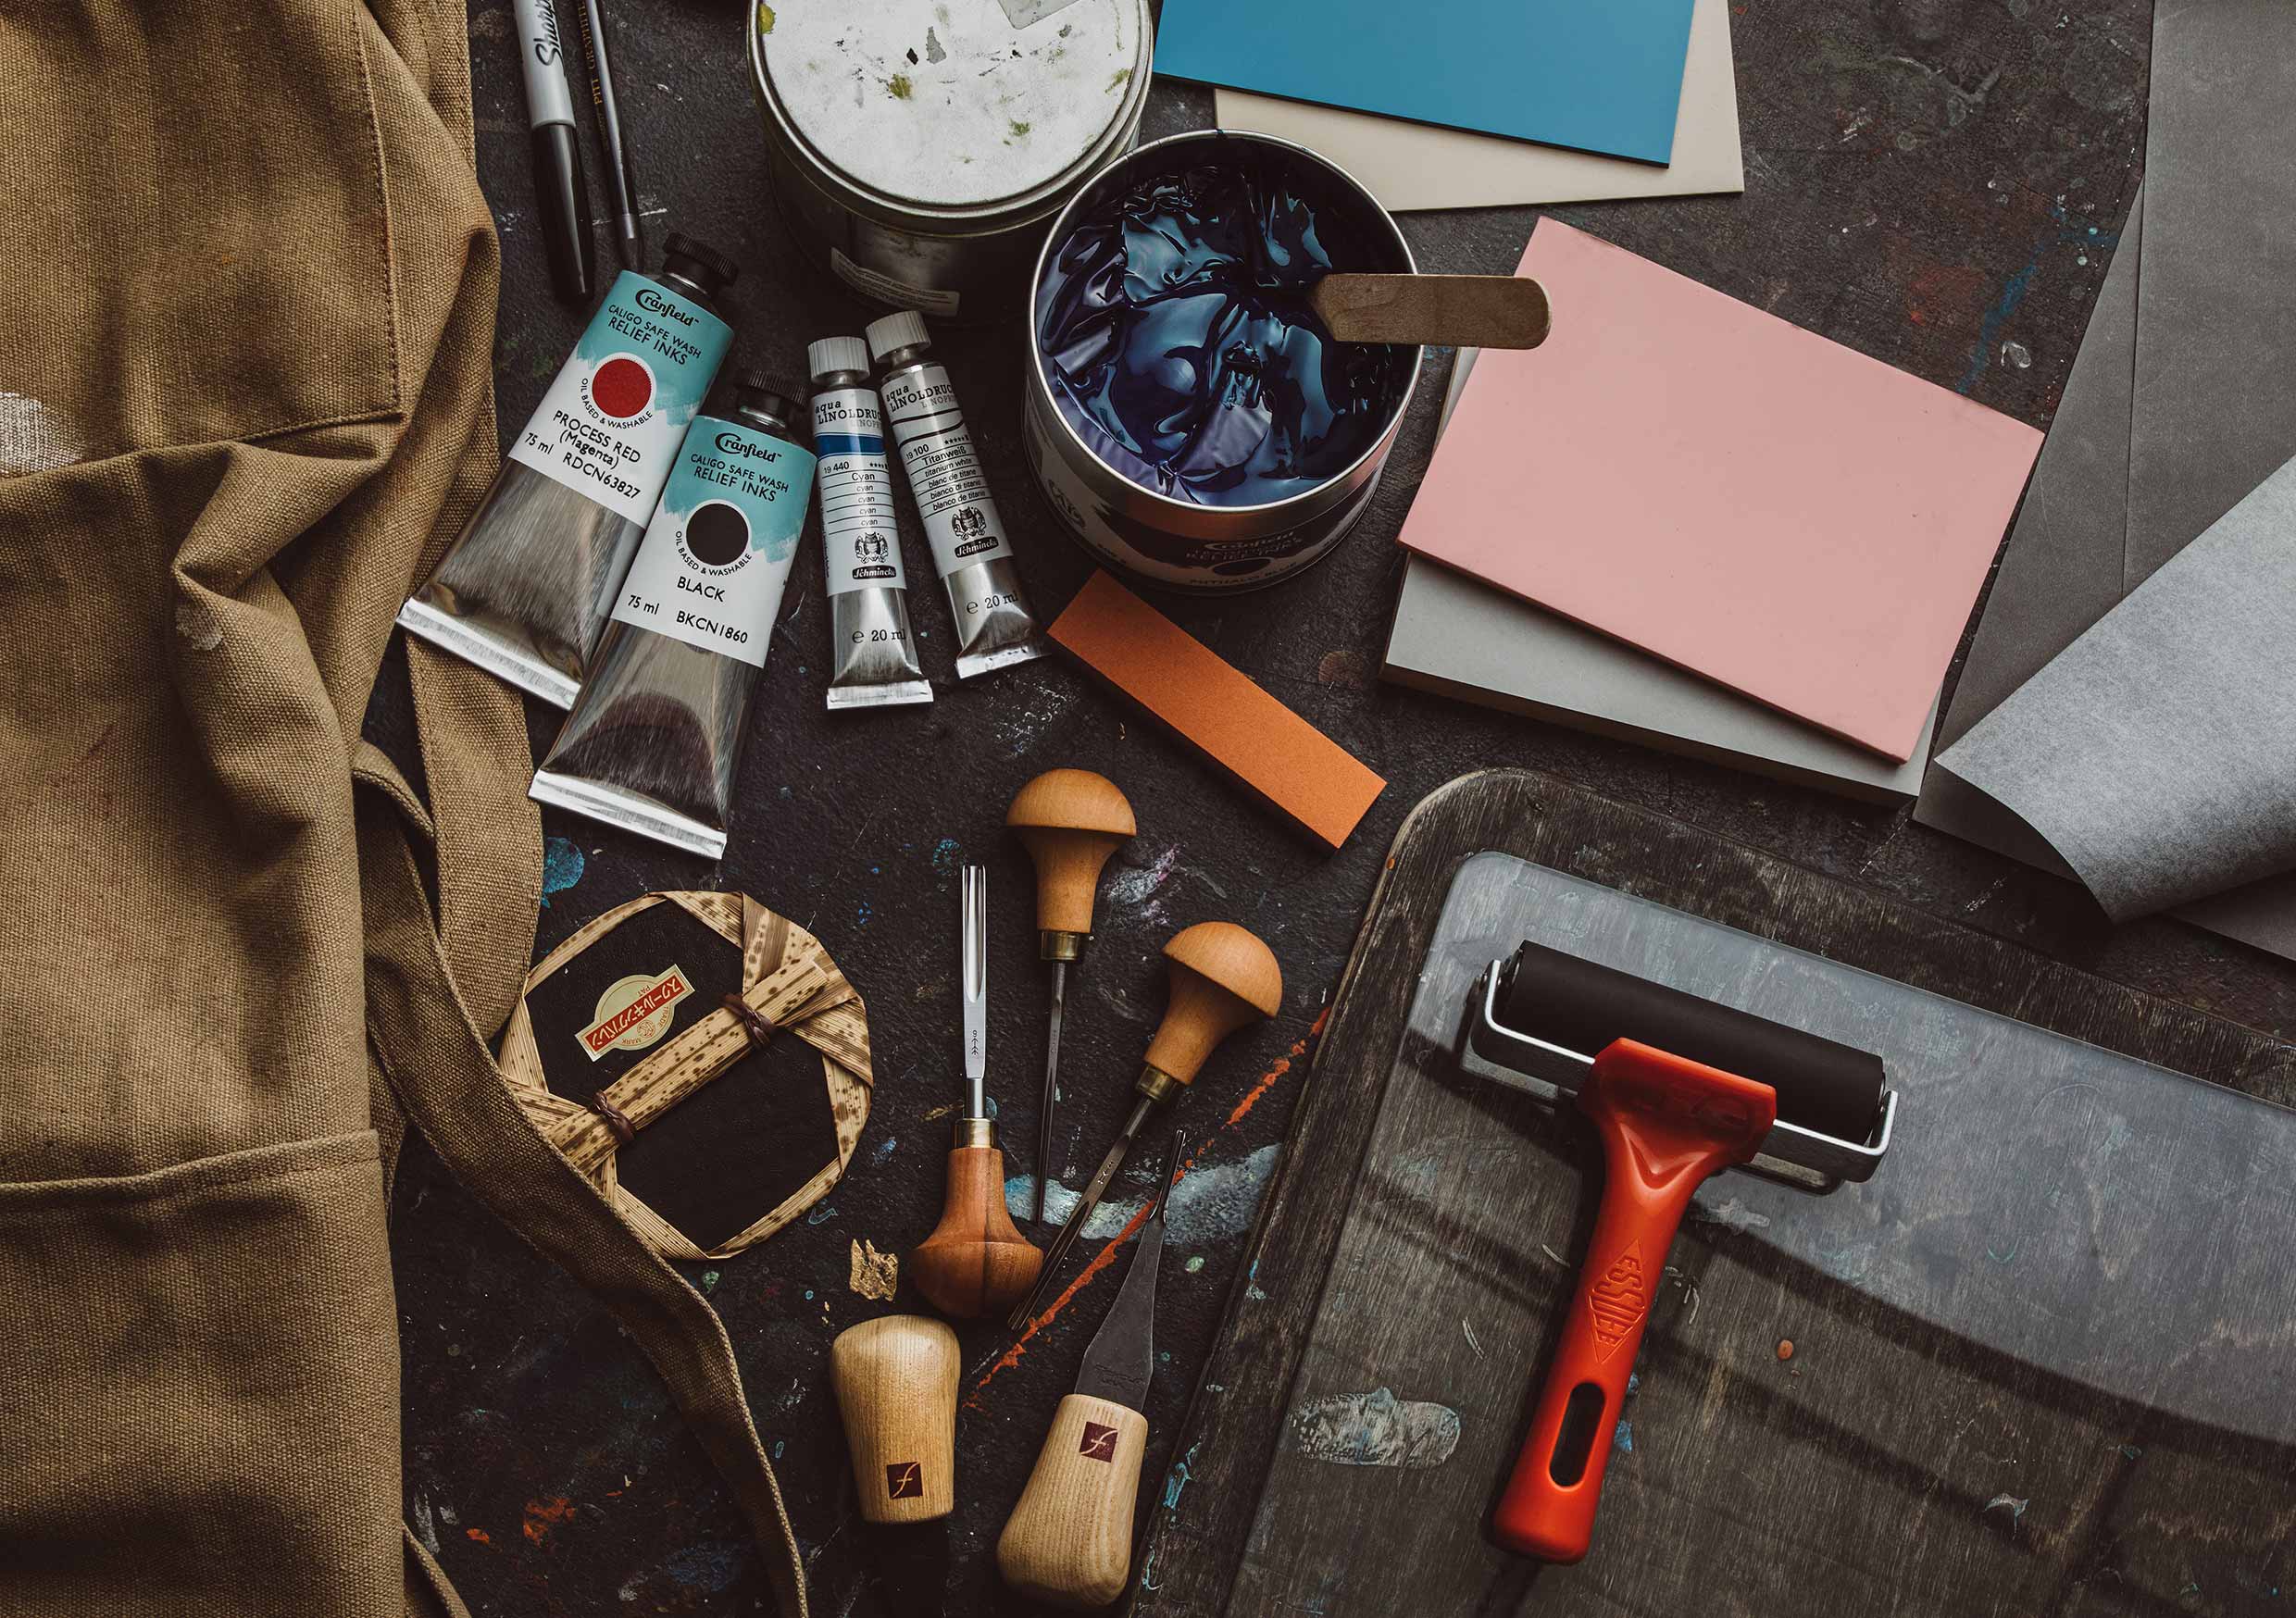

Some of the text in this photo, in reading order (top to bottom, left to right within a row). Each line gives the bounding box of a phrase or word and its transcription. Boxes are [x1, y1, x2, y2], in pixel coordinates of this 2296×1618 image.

[608, 305, 701, 358] CALIGO SAFE WASH
[608, 317, 688, 365] RELIEF INKS
[886, 385, 910, 402] aqua
[581, 394, 599, 419] BASED
[607, 410, 653, 429] WASHABLE
[815, 401, 842, 414] aqua
[524, 432, 555, 454] 75 ml
[553, 410, 642, 463] PROCESS RED
[559, 429, 619, 470] (Magenta)
[914, 444, 930, 456] 100
[922, 445, 967, 466] Titanweiß
[562, 452, 642, 499] RDCN63827
[690, 454, 790, 493] CALIGO SAFE WASH
[833, 461, 850, 471] 440
[852, 472, 875, 481] Cyan
[924, 463, 954, 478] titanium
[693, 466, 777, 503] RELIEF INKS
[929, 476, 947, 489] blanc
[948, 472, 958, 481] de
[930, 487, 954, 500] bianco
[932, 497, 956, 511] blanco
[957, 492, 967, 502] de
[859, 507, 877, 516] cyan
[861, 518, 879, 527] cyan
[678, 547, 699, 570] BASED
[700, 566, 706, 575] &
[708, 553, 753, 577] WASHABLE
[677, 576, 726, 603] BLACK
[984, 595, 1000, 609] 20
[1004, 591, 1018, 604] ml
[628, 594, 660, 615] 75 ml
[676, 610, 748, 644] BKCN1860
[871, 629, 888, 642] 20
[892, 629, 907, 641] ml
[592, 977, 681, 1047] スクールキングバレン
